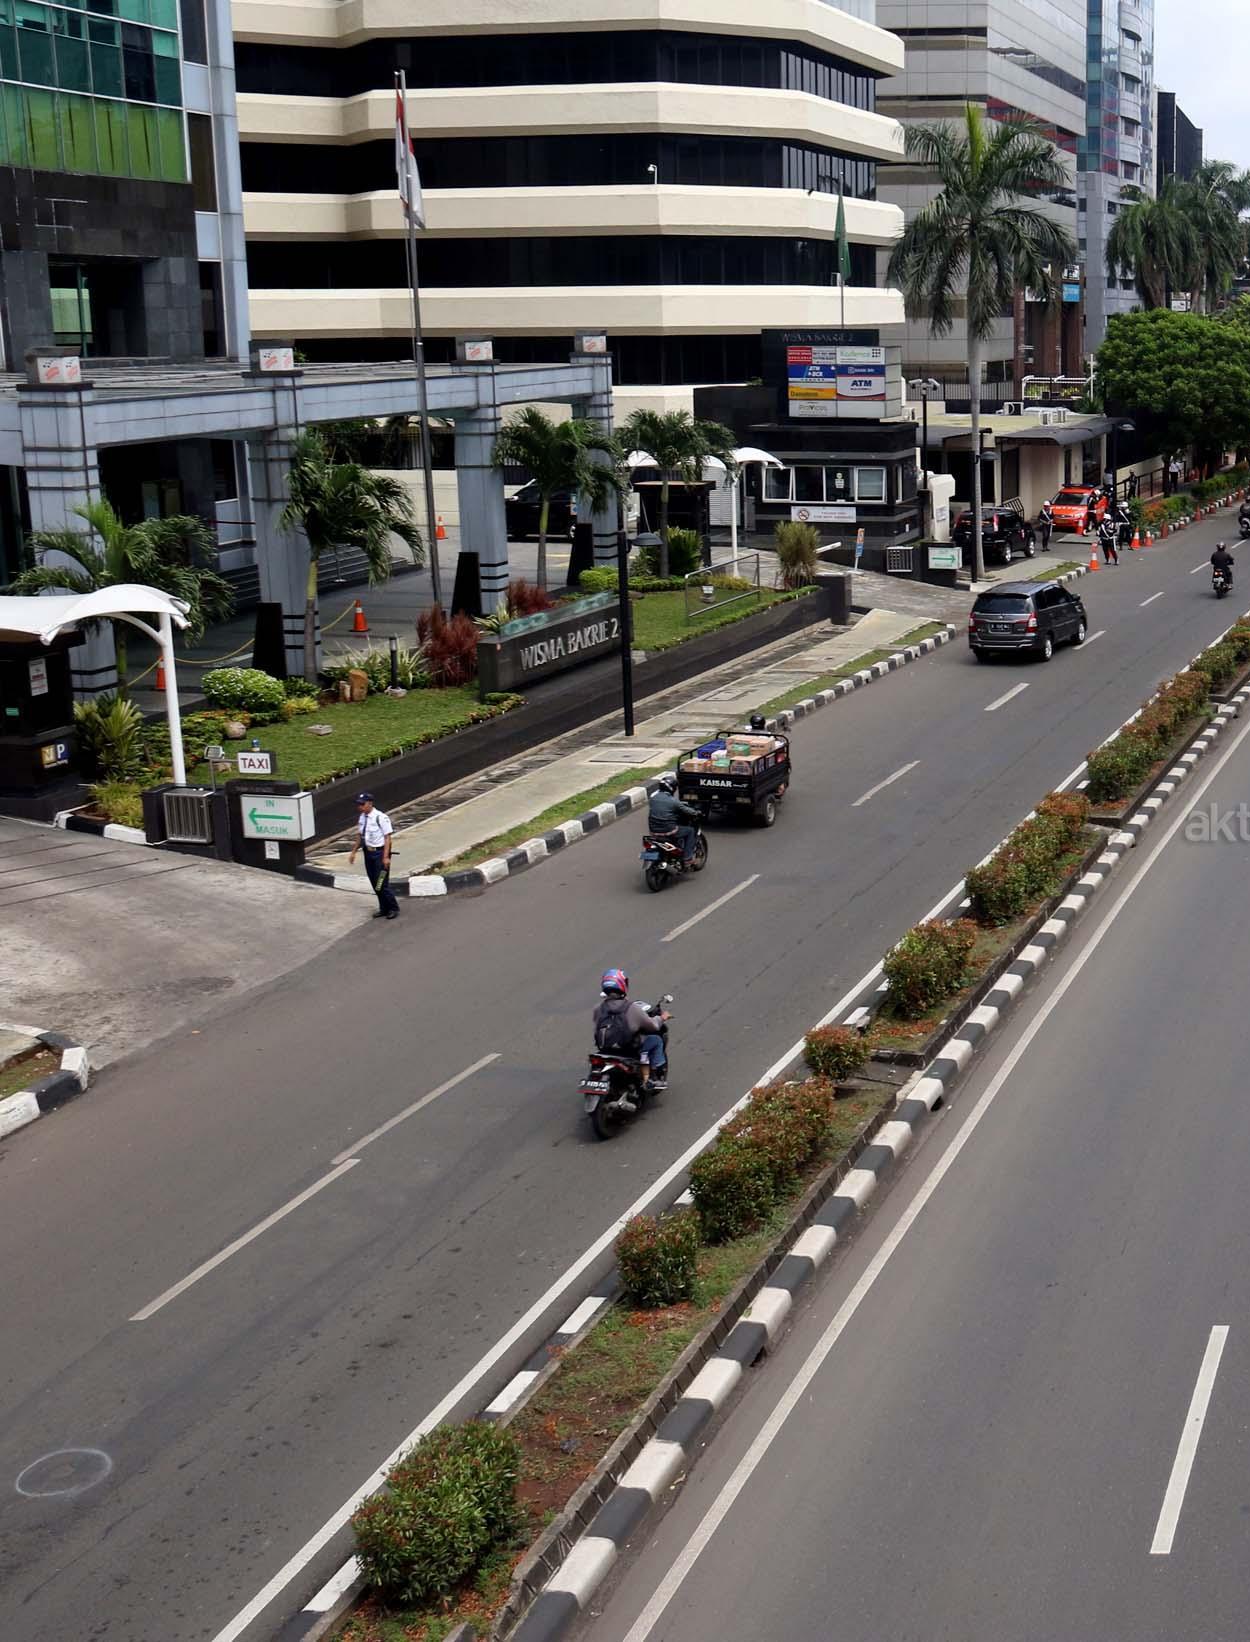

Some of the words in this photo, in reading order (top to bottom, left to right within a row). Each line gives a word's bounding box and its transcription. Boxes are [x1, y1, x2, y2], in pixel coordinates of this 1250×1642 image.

[520, 637, 566, 670] WISMA
[567, 621, 609, 653] BAKRIE
[611, 618, 619, 638] 2
[240, 757, 269, 769] TAXI
[699, 778, 733, 788] KAISAR
[256, 825, 288, 835] MASUK
